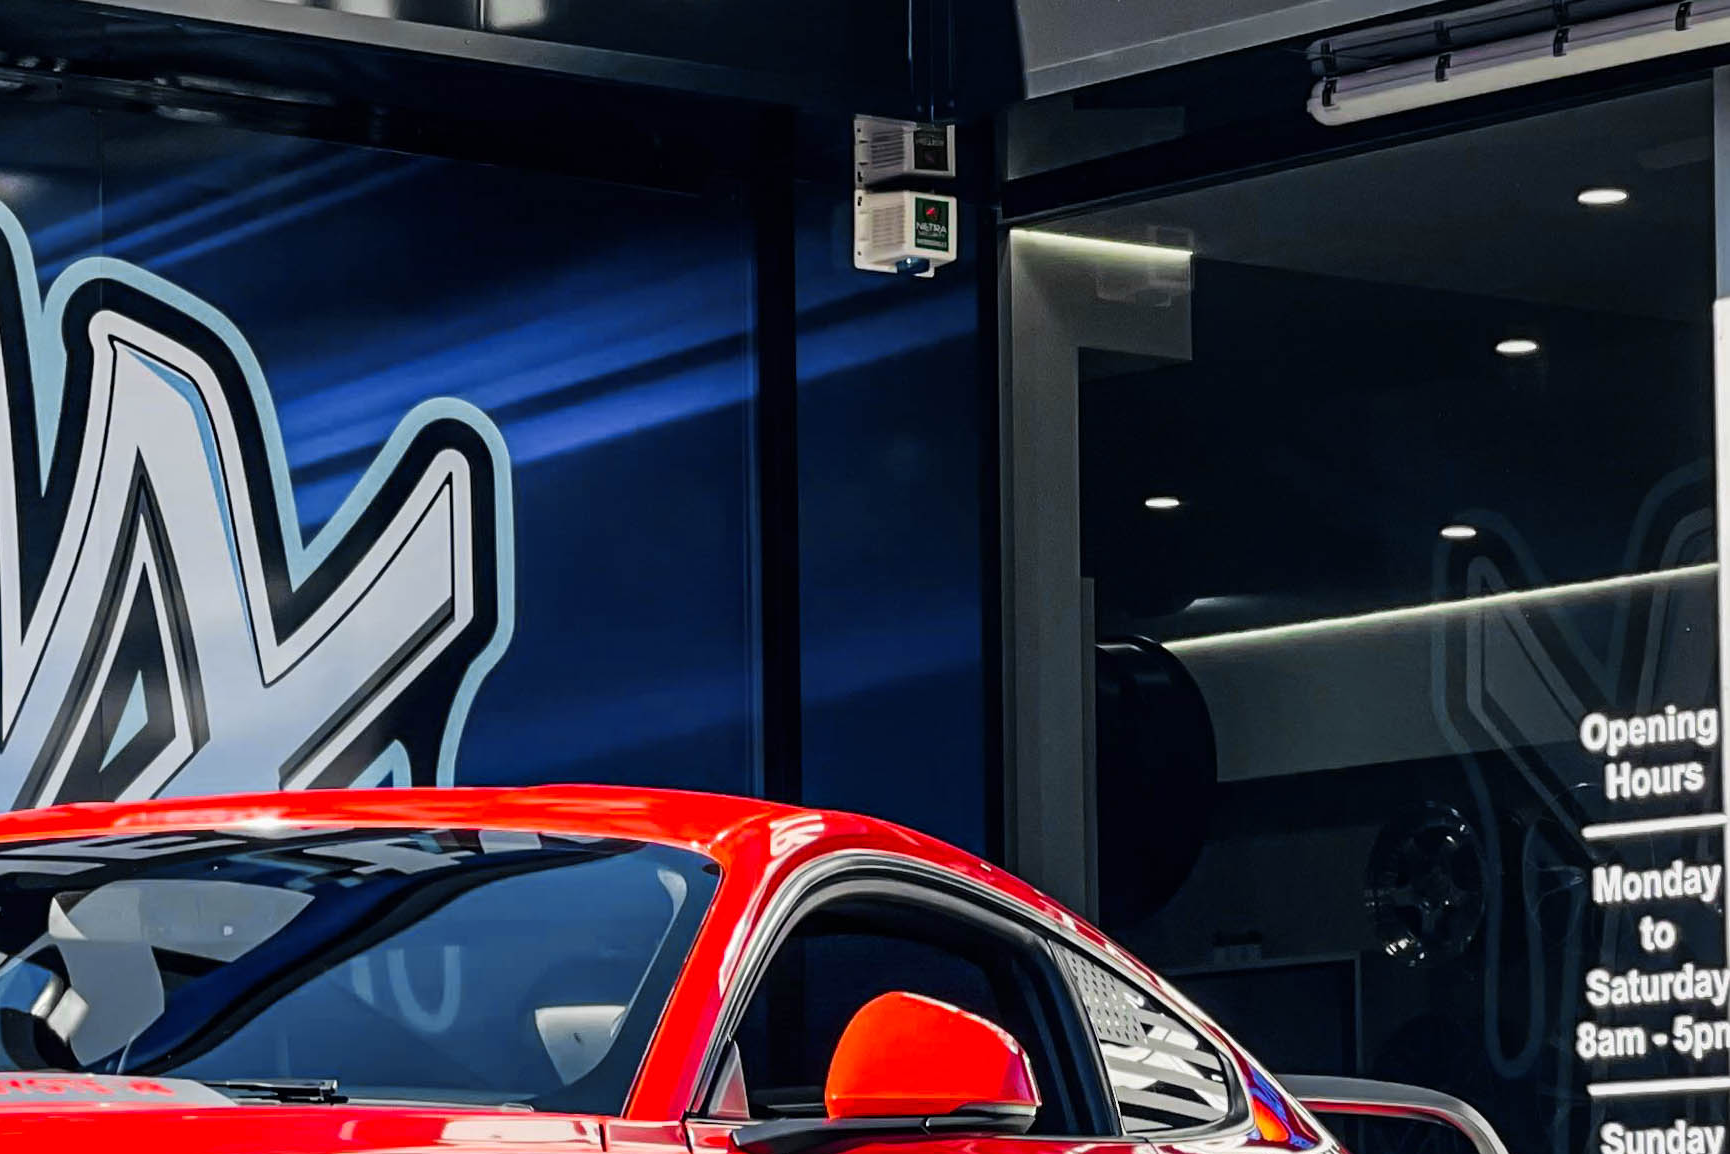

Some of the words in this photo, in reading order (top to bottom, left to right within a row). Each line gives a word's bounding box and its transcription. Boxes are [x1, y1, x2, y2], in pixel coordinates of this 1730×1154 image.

[1579, 704, 1719, 756] Opening
[1605, 759, 1705, 801] Hours
[1592, 859, 1723, 904] Monday
[1638, 915, 1677, 953] to
[1585, 963, 1730, 1007] Saturday
[1576, 1021, 1647, 1060] 8am
